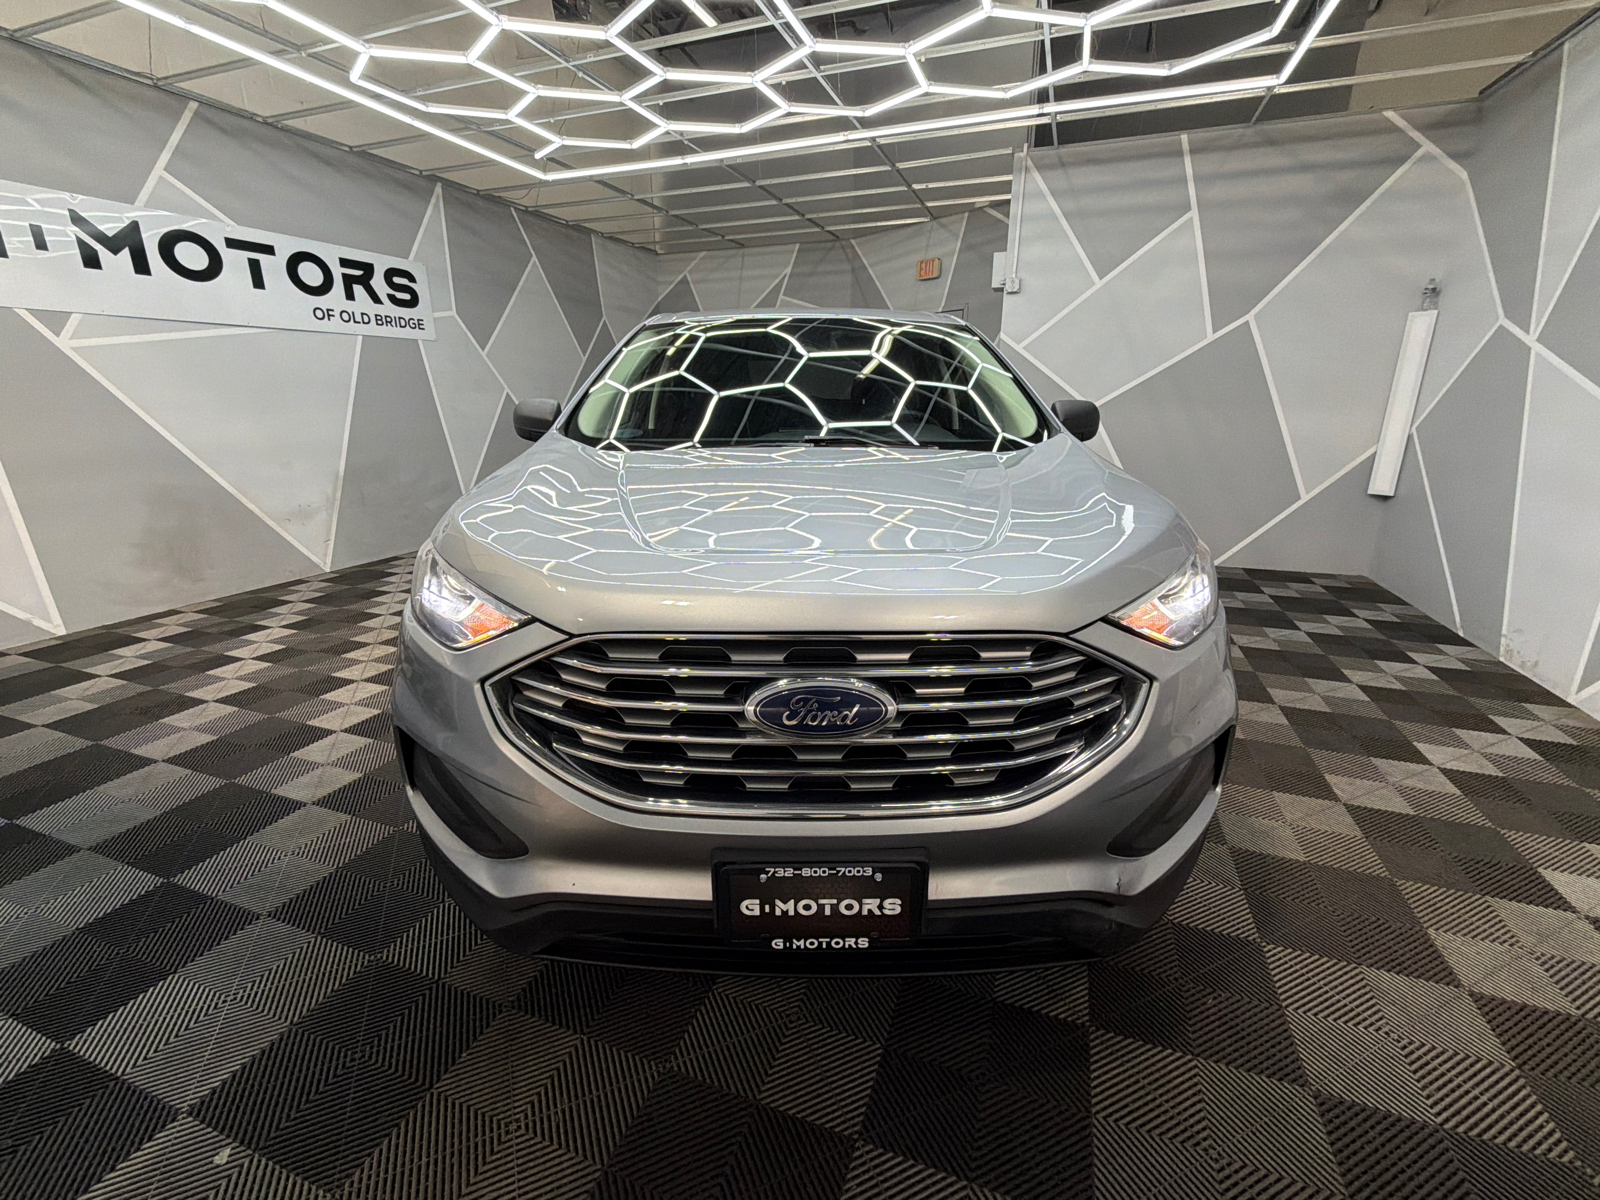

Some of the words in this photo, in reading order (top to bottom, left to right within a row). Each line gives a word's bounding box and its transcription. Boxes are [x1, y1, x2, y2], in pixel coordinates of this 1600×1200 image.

[919, 259, 936, 278] EXIT
[312, 306, 336, 322] OF
[339, 309, 372, 325] OLD
[374, 313, 426, 331] BRIDGE
[782, 694, 861, 726] Ford
[765, 867, 873, 877] 732-800-7003
